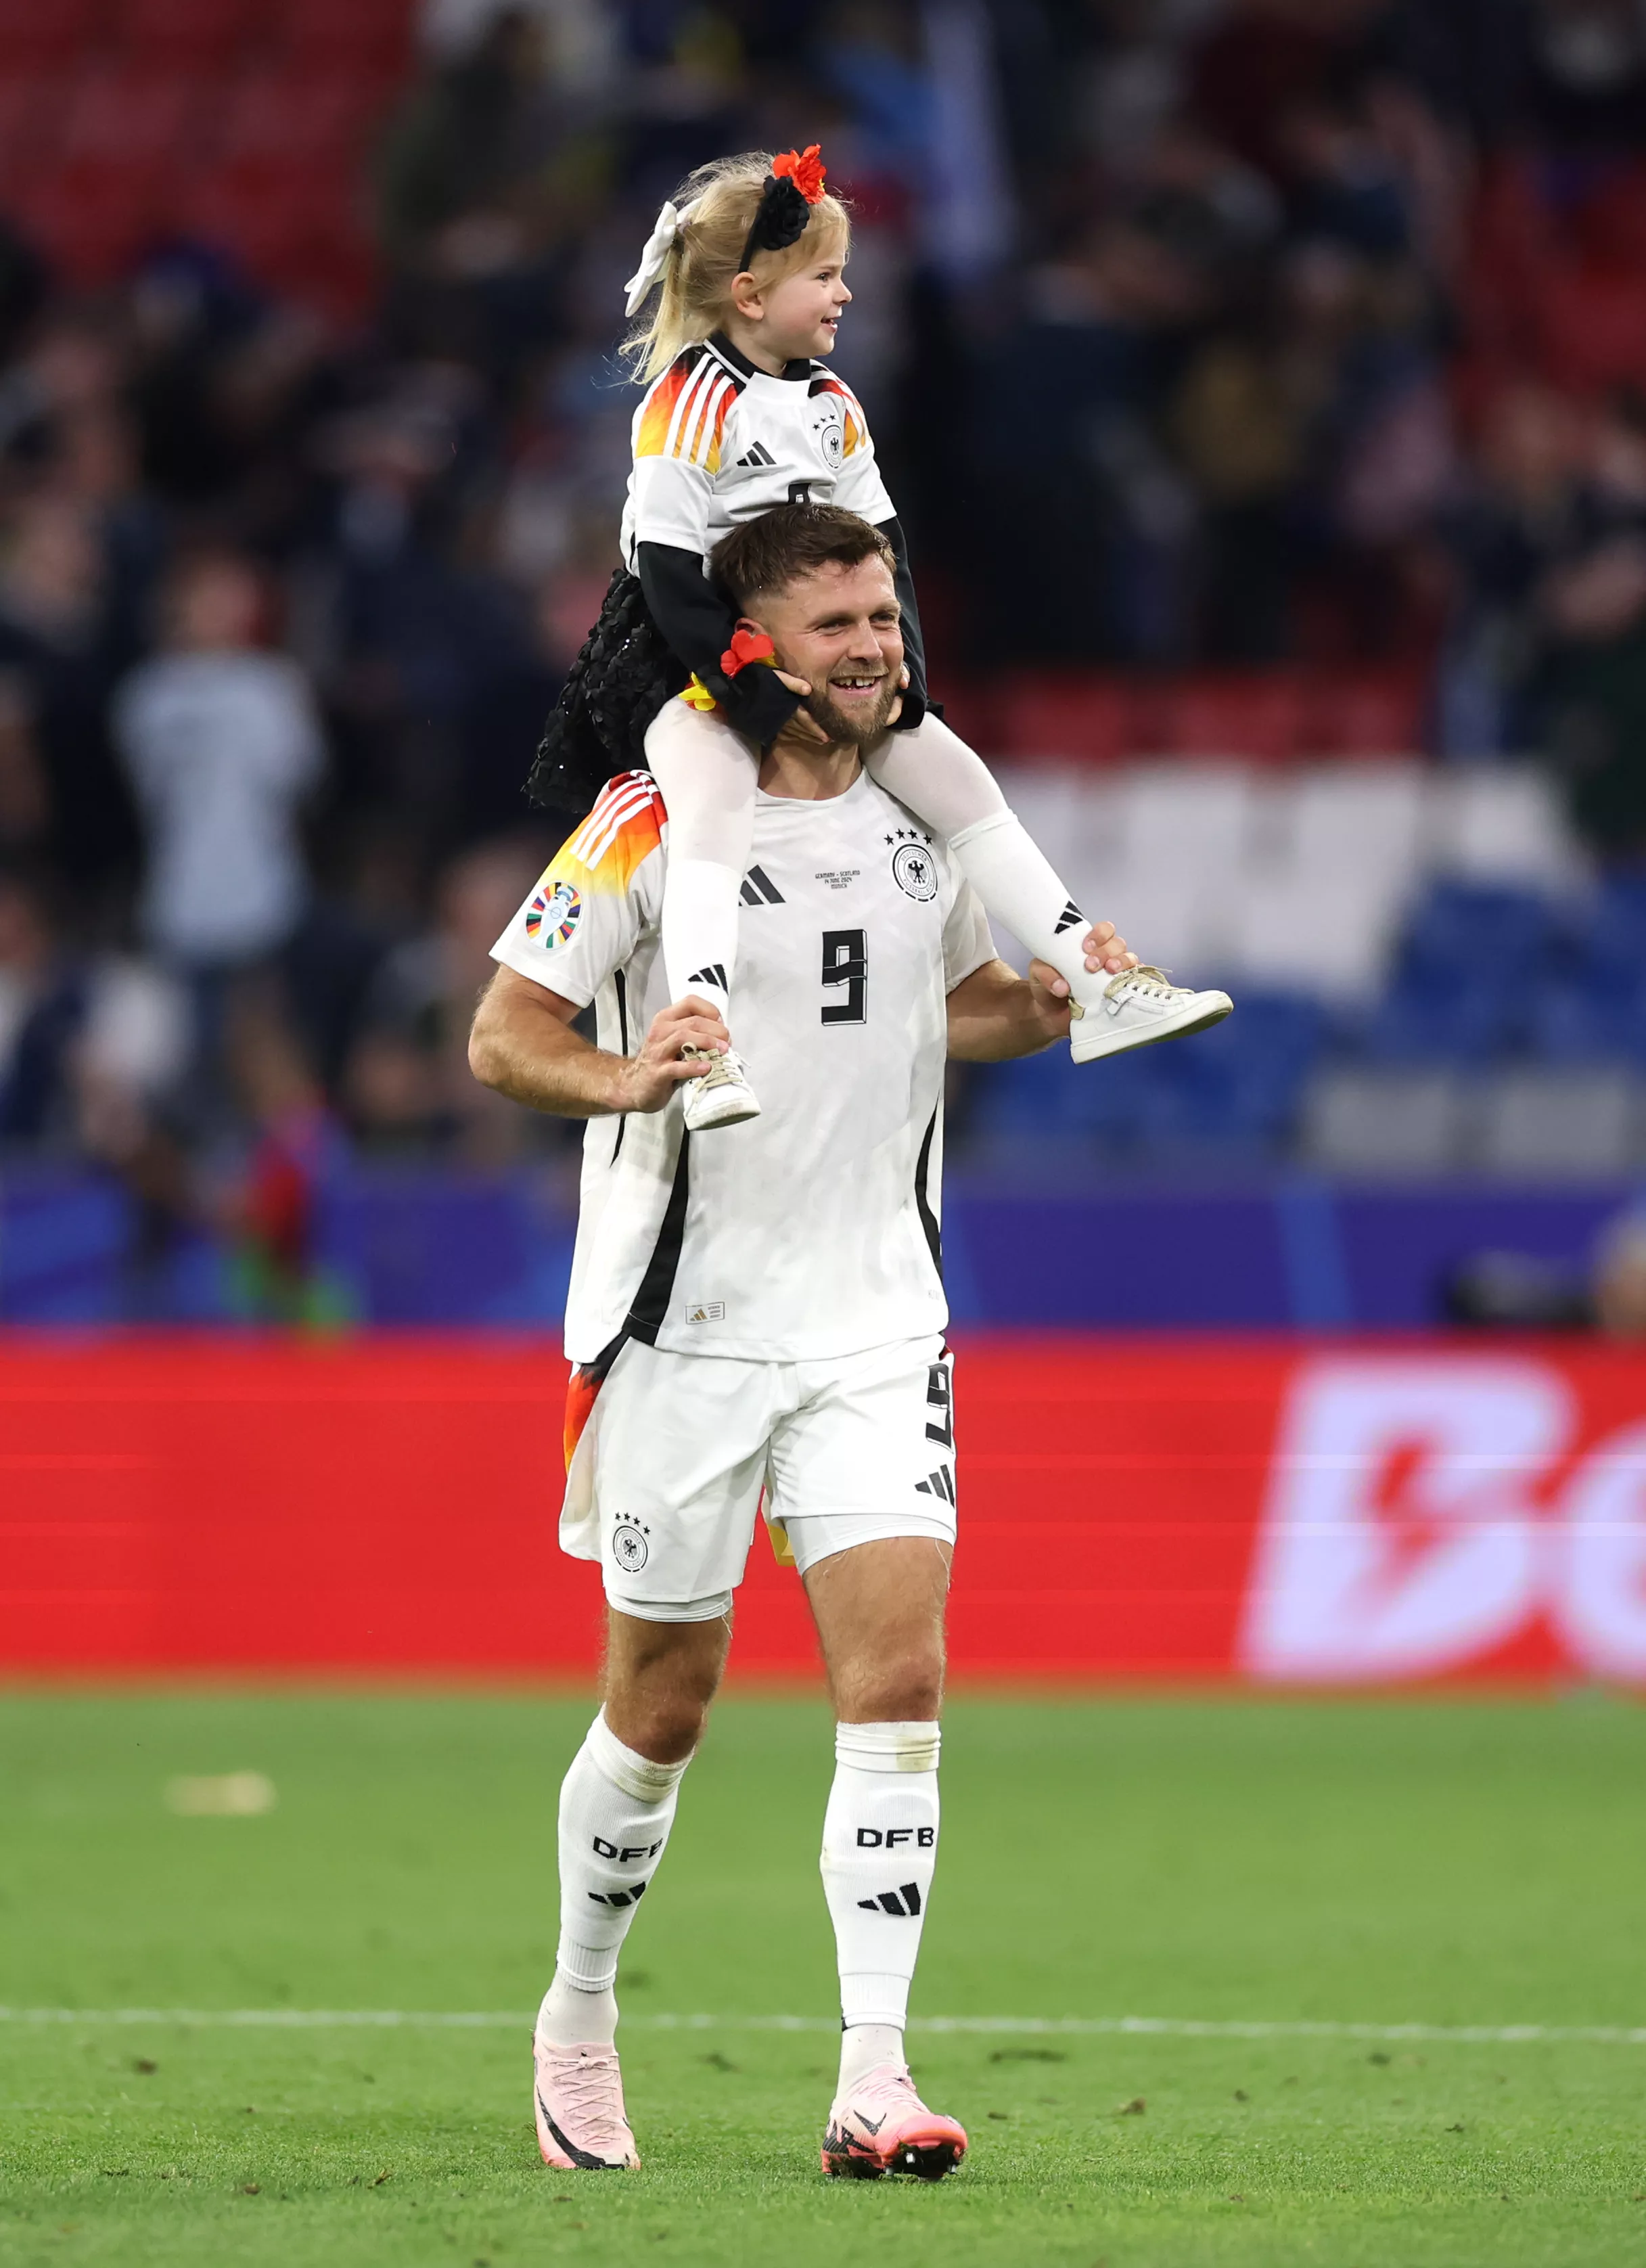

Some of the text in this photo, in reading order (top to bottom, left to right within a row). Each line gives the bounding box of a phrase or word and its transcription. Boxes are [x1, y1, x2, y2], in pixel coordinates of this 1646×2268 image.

[900, 850, 928, 862] DEUTSCHER
[821, 928, 869, 1027] 9
[925, 1362, 955, 1455] 9
[856, 1827, 934, 1849] DFB
